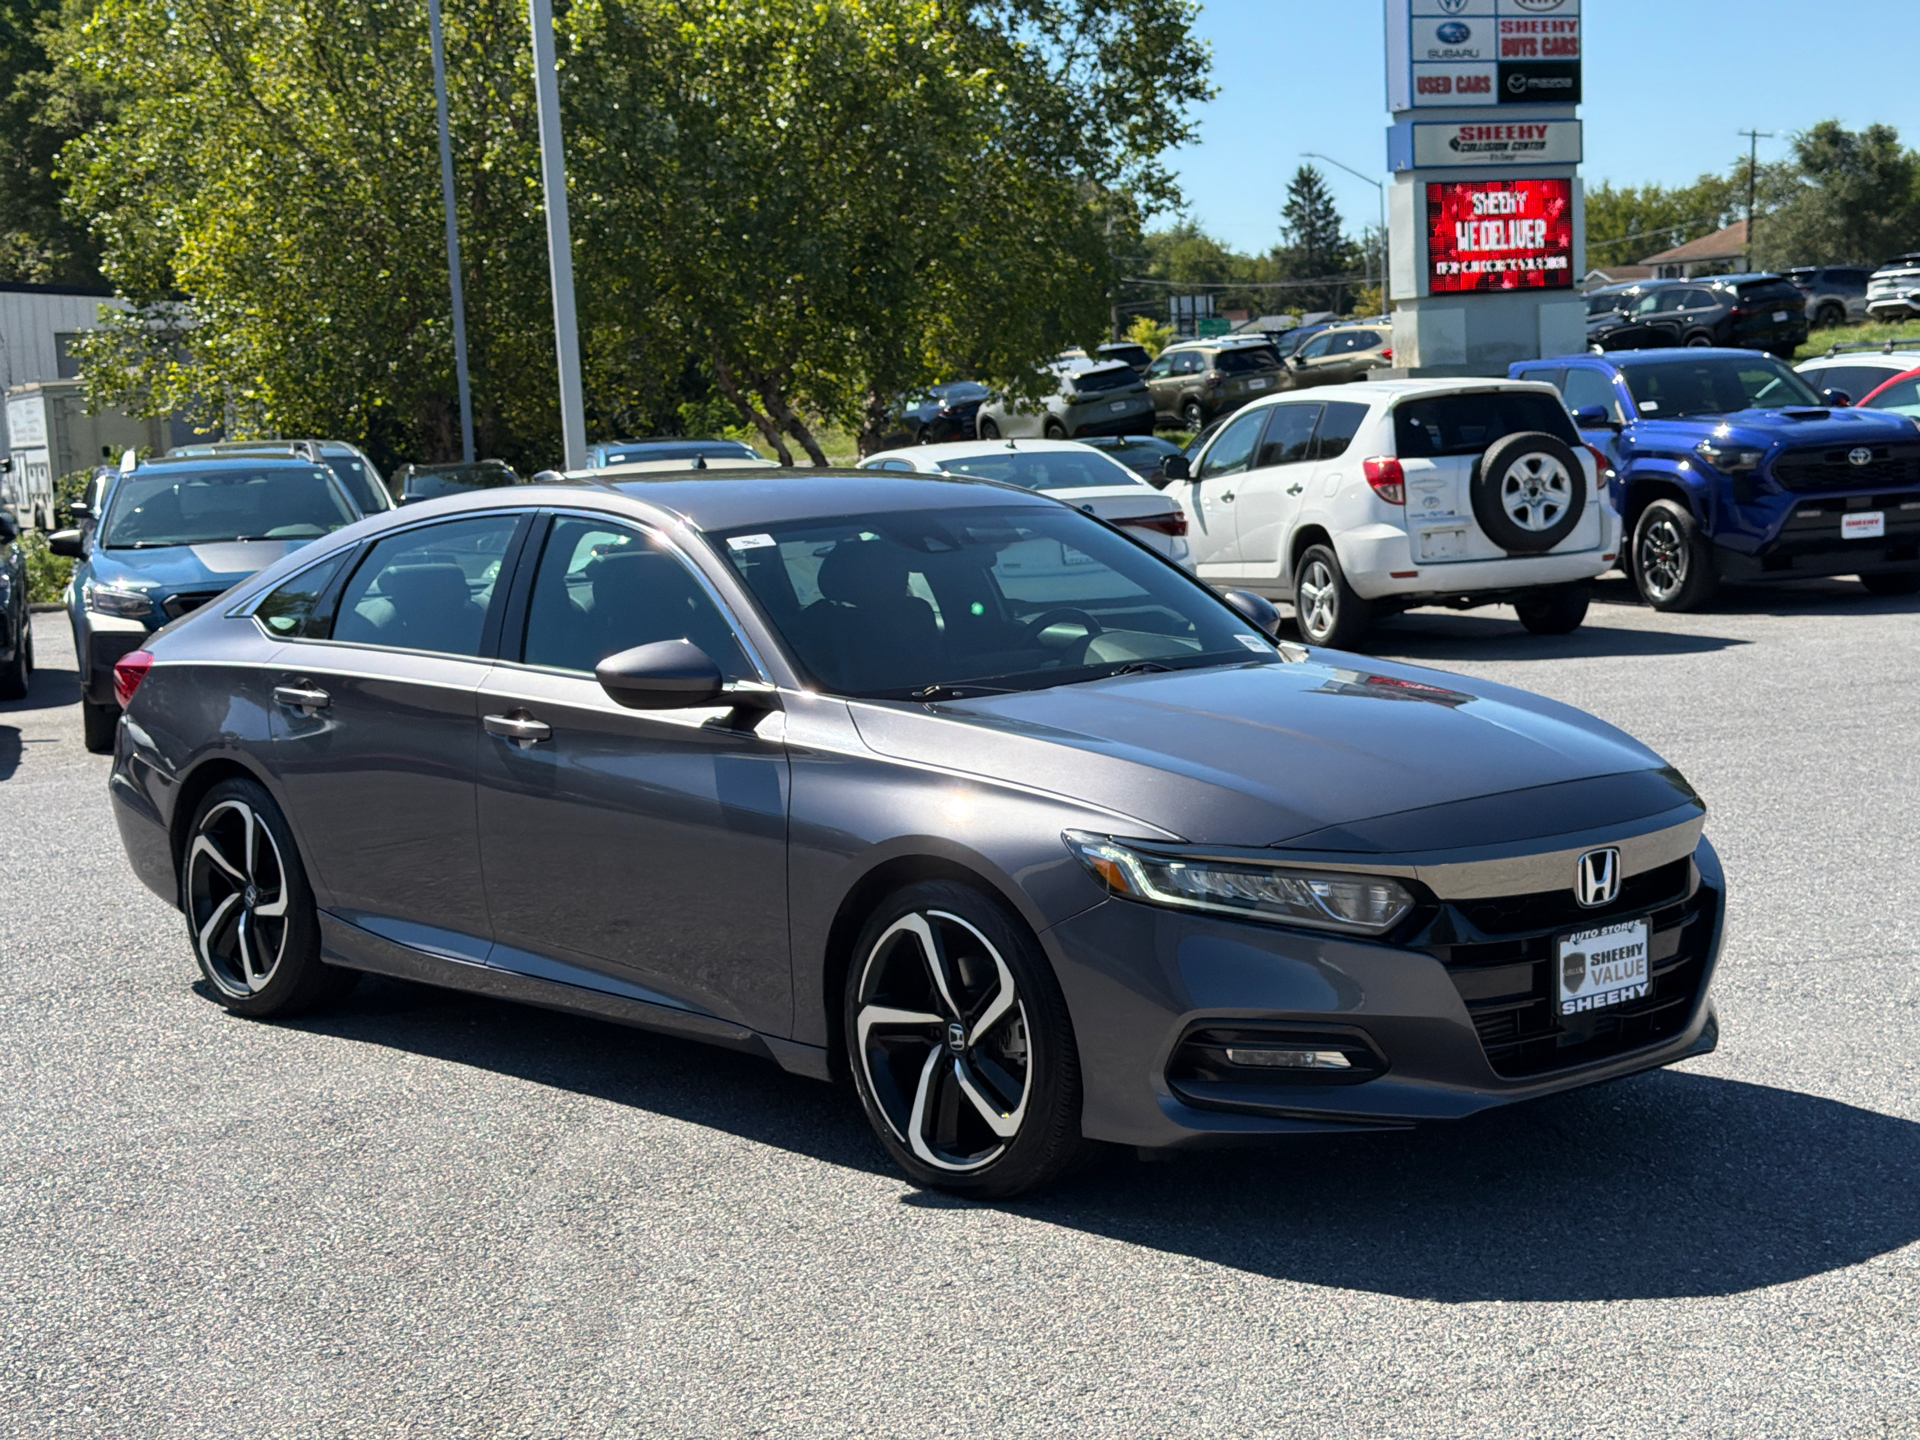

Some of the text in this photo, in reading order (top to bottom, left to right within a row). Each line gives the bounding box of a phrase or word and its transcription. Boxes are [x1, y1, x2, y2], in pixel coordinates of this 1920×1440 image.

[1500, 20, 1577, 34] SHEEHY
[1428, 48, 1479, 58] SUBARU
[1501, 37, 1578, 57] BUYS CARS
[1417, 75, 1491, 94] USED CARS
[1459, 125, 1548, 141] SHEEHY
[1569, 929, 1599, 943] AUTO
[1590, 942, 1644, 967] SHEEHY
[1591, 958, 1645, 986] VALUE
[1562, 982, 1649, 1015] SHEEHY
